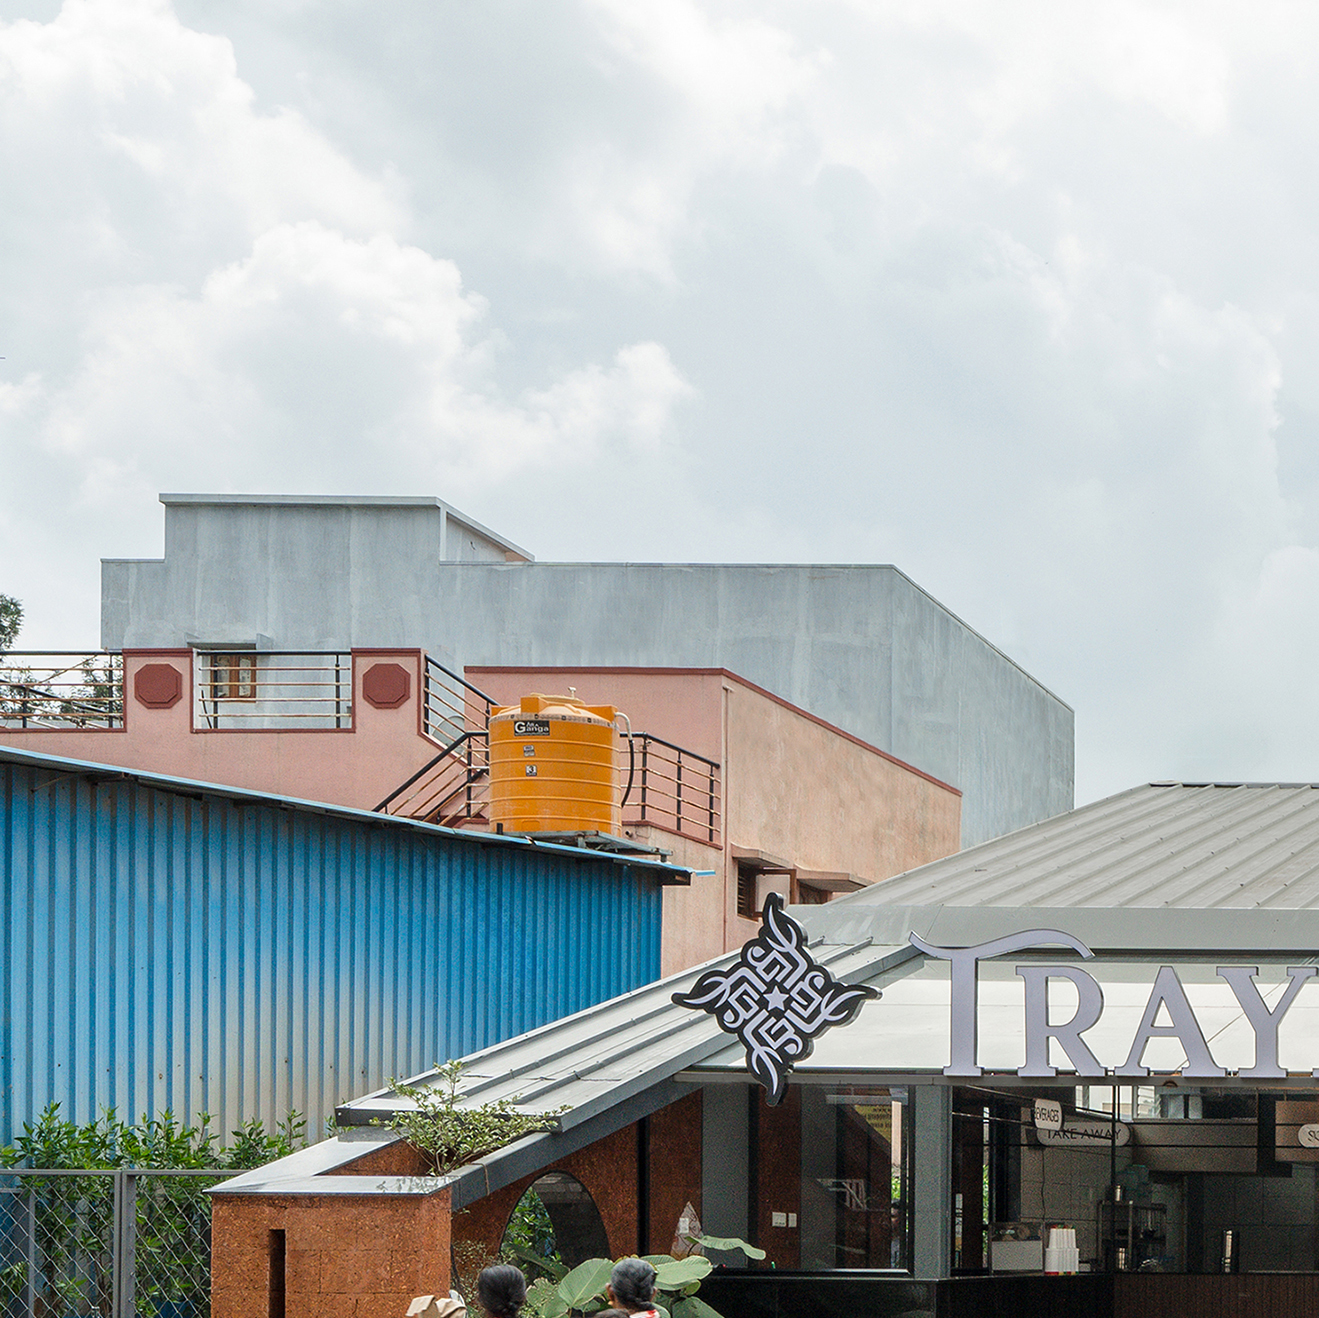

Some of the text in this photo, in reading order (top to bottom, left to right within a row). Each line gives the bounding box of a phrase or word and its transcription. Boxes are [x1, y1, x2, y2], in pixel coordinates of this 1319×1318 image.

[514, 721, 549, 733] Ganga
[1047, 1128, 1121, 1140] TAKE AWAY
